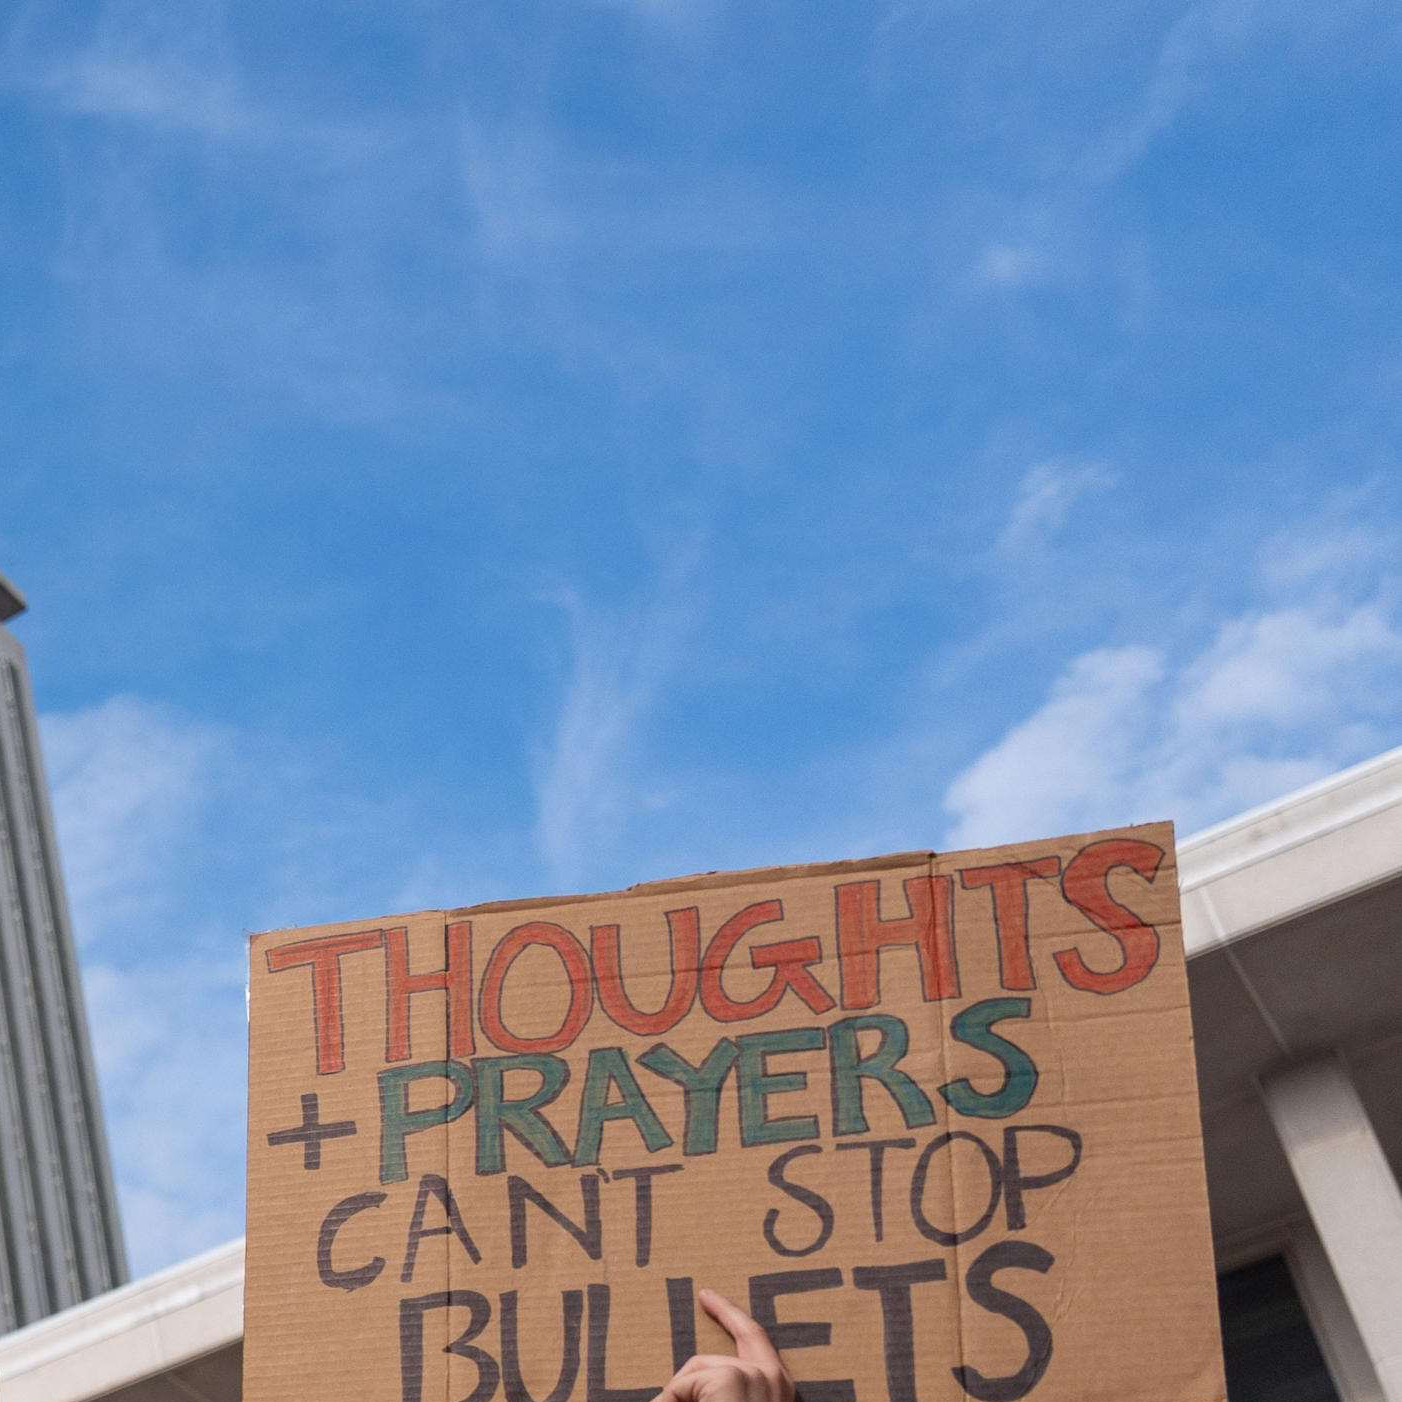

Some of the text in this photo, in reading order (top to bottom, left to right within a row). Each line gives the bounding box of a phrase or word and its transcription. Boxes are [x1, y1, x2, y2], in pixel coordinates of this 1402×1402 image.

[265, 837, 1166, 1077] THOUGHTS
[377, 997, 1039, 1184] PRAYERS
[762, 1123, 1083, 1258] STOP
